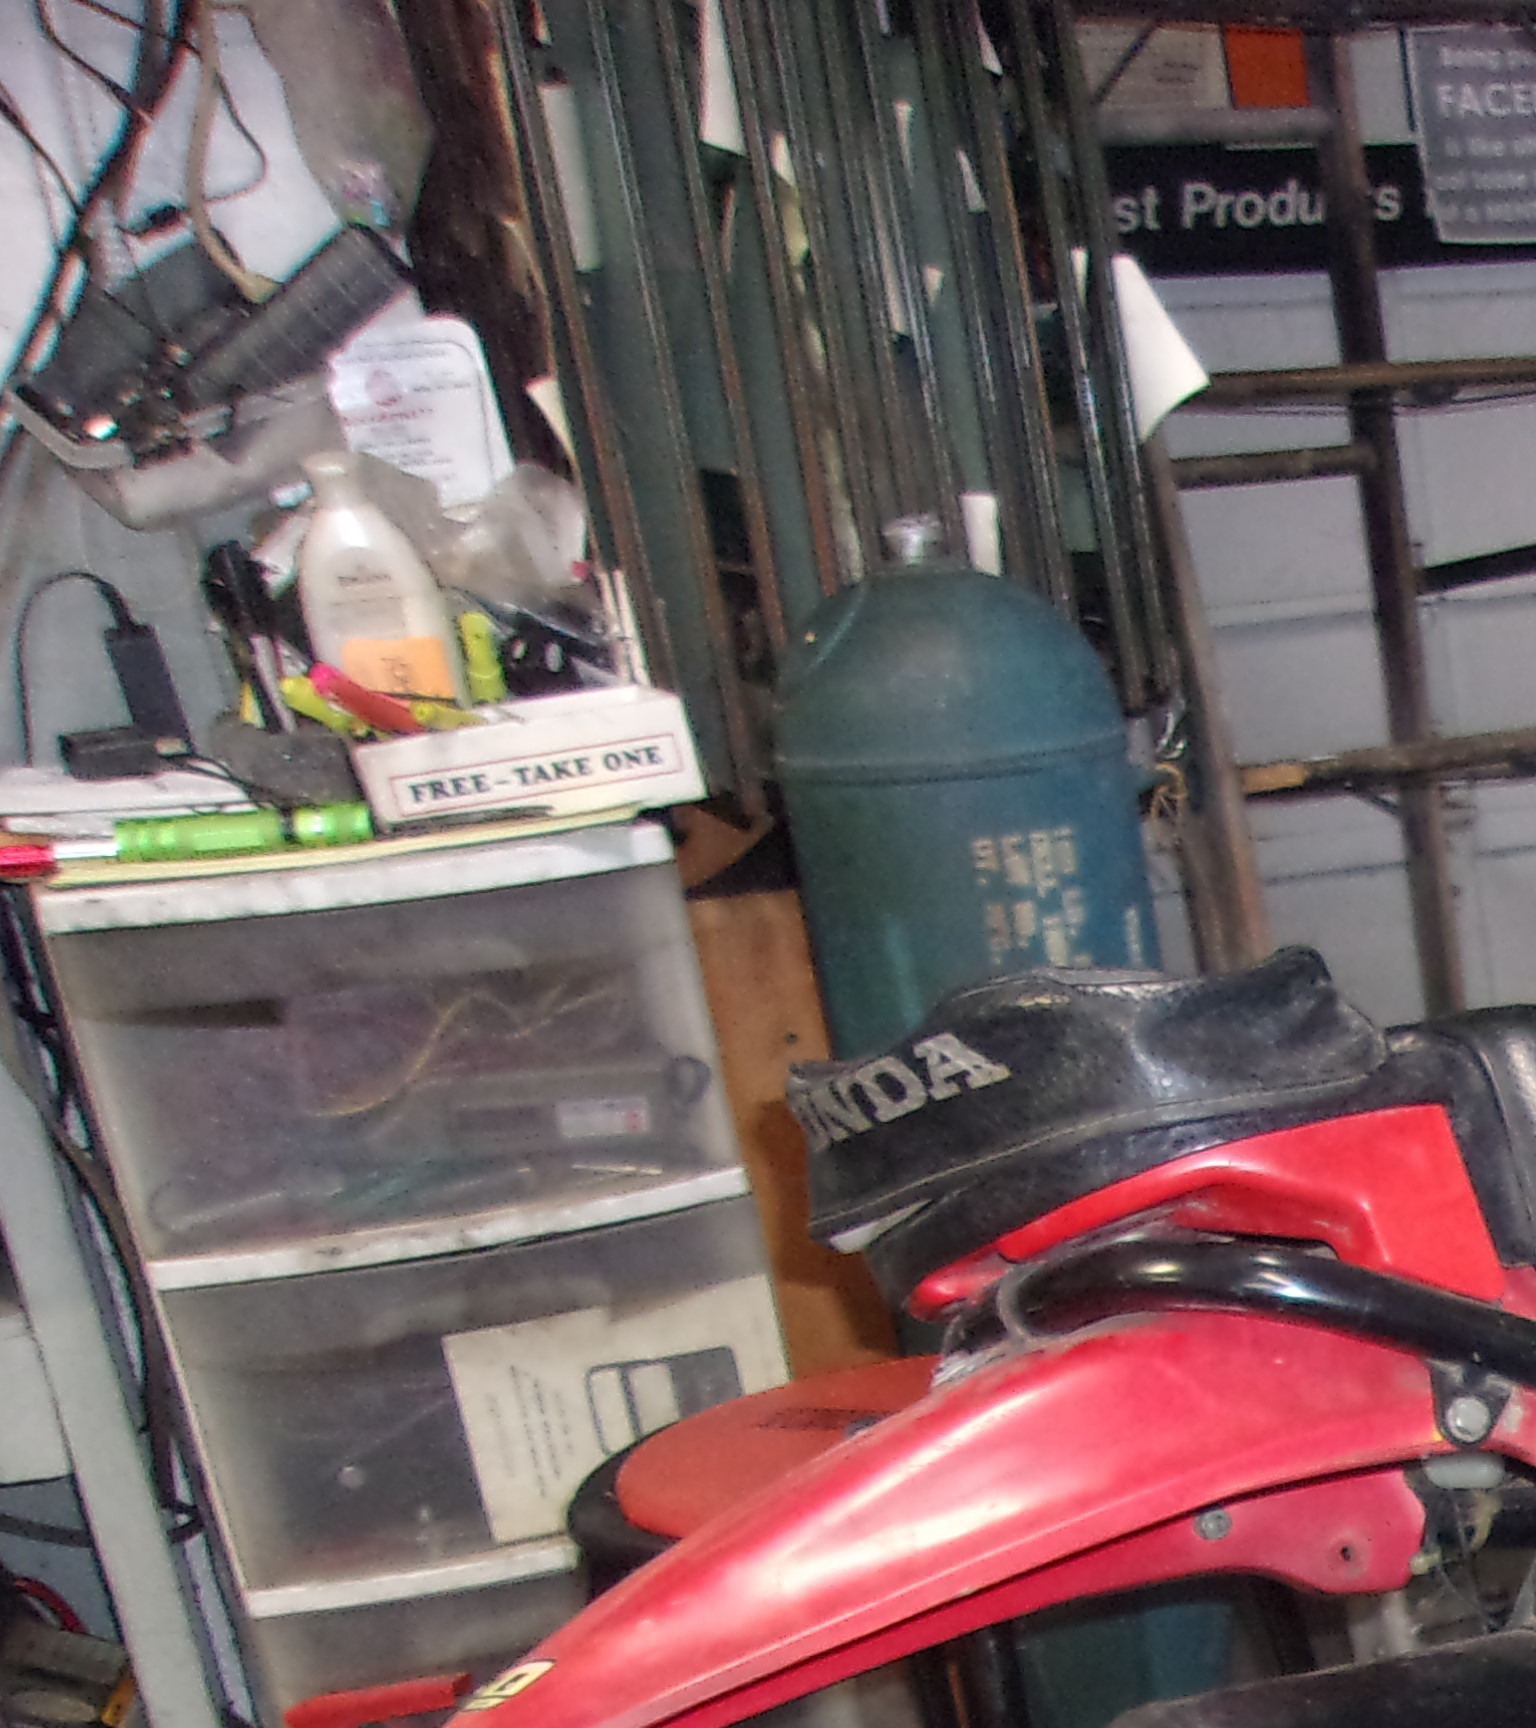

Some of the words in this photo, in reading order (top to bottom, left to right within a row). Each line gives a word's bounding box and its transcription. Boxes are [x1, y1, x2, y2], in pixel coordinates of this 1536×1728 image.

[1113, 186, 1161, 234] st
[1181, 177, 1402, 231] Produs
[603, 745, 663, 773] ONE
[785, 1031, 1013, 1154] NDA
